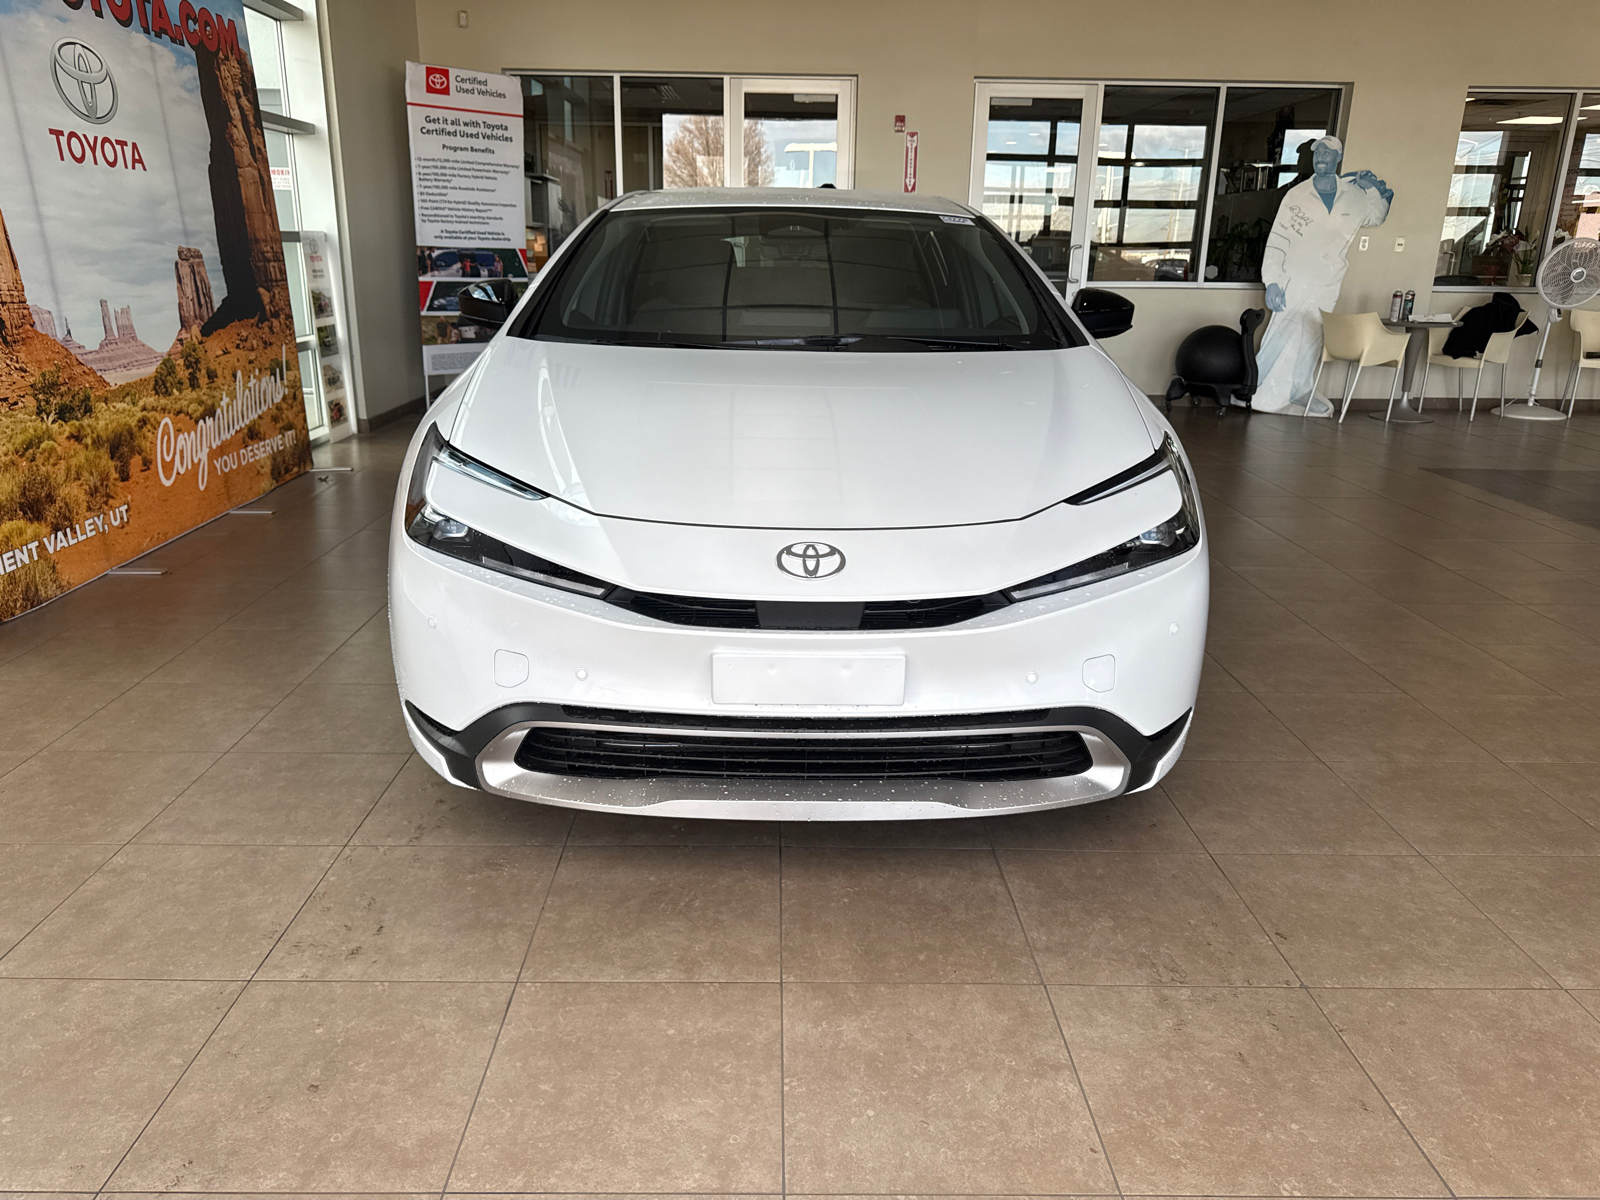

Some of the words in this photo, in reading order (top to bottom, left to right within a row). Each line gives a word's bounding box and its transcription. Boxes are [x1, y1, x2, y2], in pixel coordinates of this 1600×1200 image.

[62, 0, 240, 60] TA.COM
[455, 74, 488, 86] Certified
[456, 85, 476, 95] Used
[476, 88, 506, 99] Vehicles
[420, 126, 458, 137] Certified
[459, 130, 480, 139] Used
[480, 132, 514, 142] Vehicles
[424, 115, 440, 124] Get
[442, 116, 449, 125] it
[450, 118, 462, 126] all
[462, 119, 481, 128] with
[482, 120, 508, 132] Toyota
[48, 128, 147, 172] TOYOTA
[442, 144, 470, 153] Program
[470, 146, 495, 154] Benefits
[157, 344, 288, 491] Congratulations!
[214, 452, 238, 476] YOU
[240, 434, 284, 466] DESERVE
[284, 429, 297, 448] IT!
[42, 514, 109, 554] VALLEY,
[108, 504, 128, 526] UT
